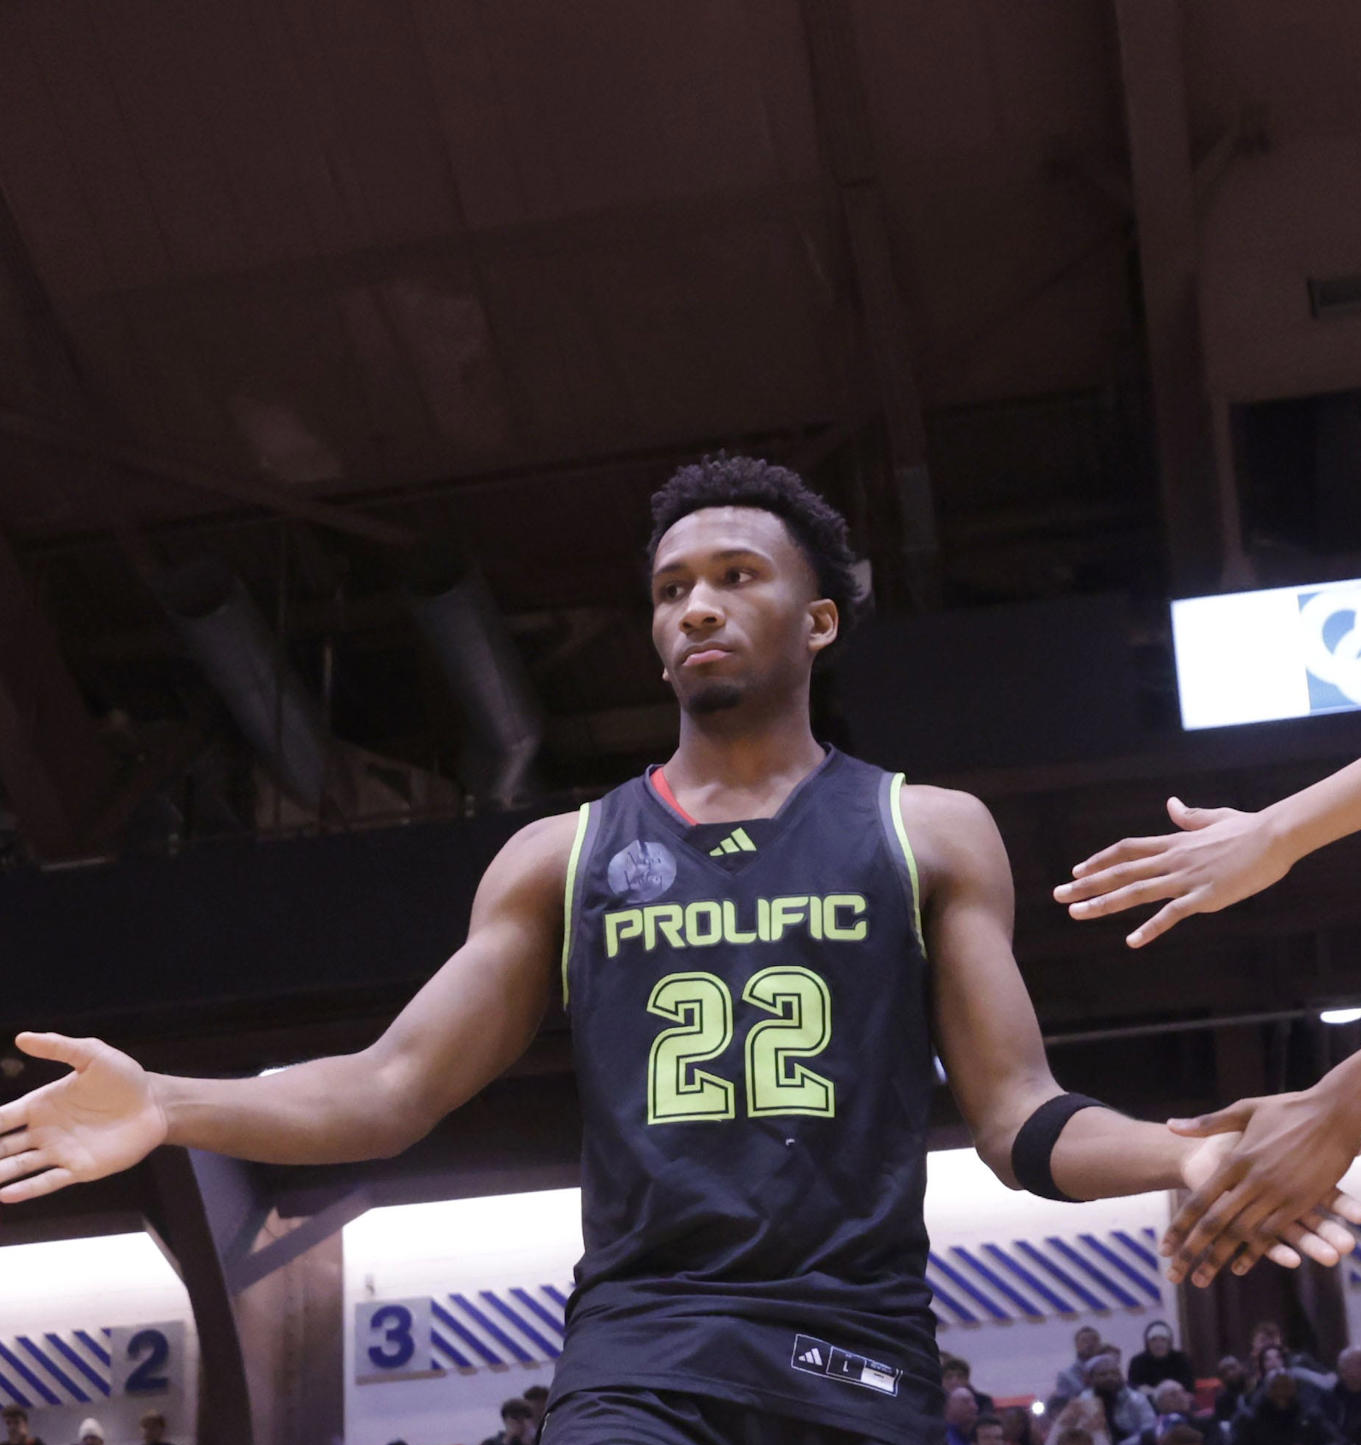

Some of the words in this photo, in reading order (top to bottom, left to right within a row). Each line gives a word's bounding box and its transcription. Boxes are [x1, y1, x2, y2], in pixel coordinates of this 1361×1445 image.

[604, 894, 868, 959] PROLIFIC
[646, 965, 836, 1126] 22
[124, 1328, 171, 1394] 2
[367, 1304, 416, 1370] 3
